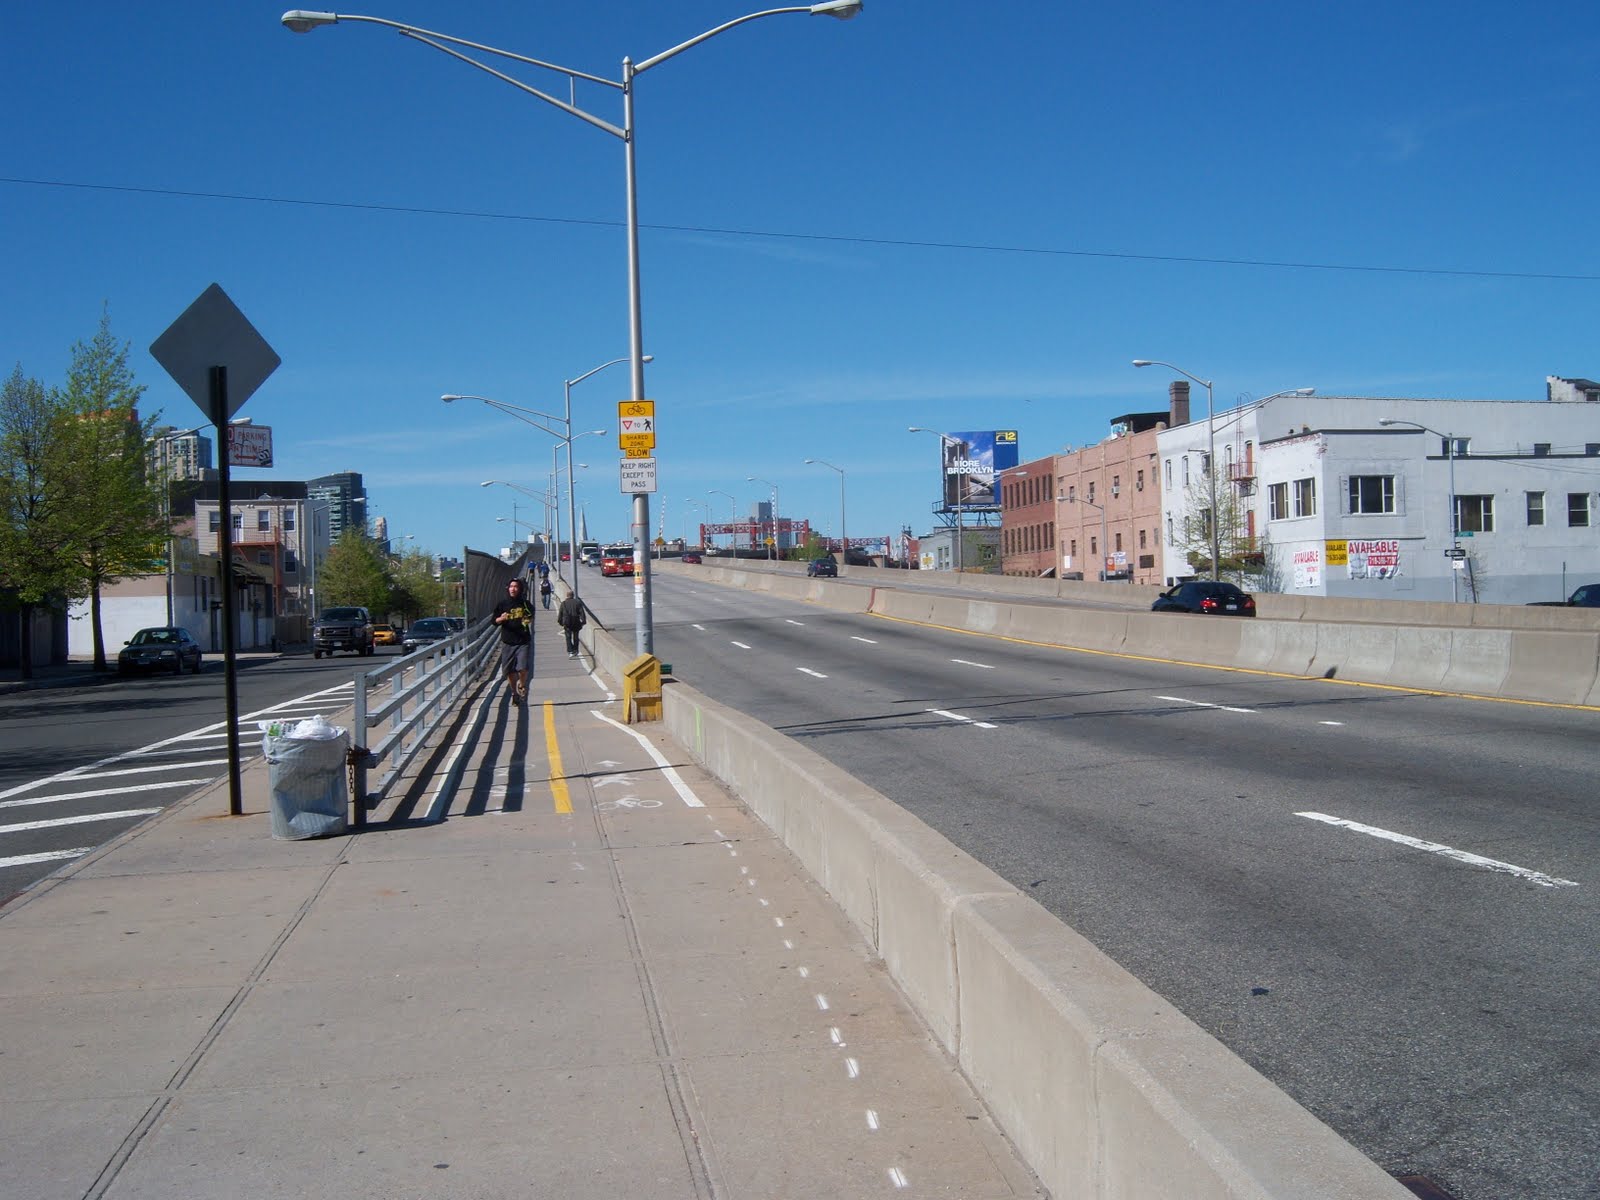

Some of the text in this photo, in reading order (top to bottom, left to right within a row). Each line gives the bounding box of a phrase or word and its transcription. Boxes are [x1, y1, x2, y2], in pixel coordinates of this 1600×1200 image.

[238, 432, 266, 440] PARKING
[1349, 541, 1398, 553] AVAILABLE
[1295, 551, 1318, 563] AVAILABLE
